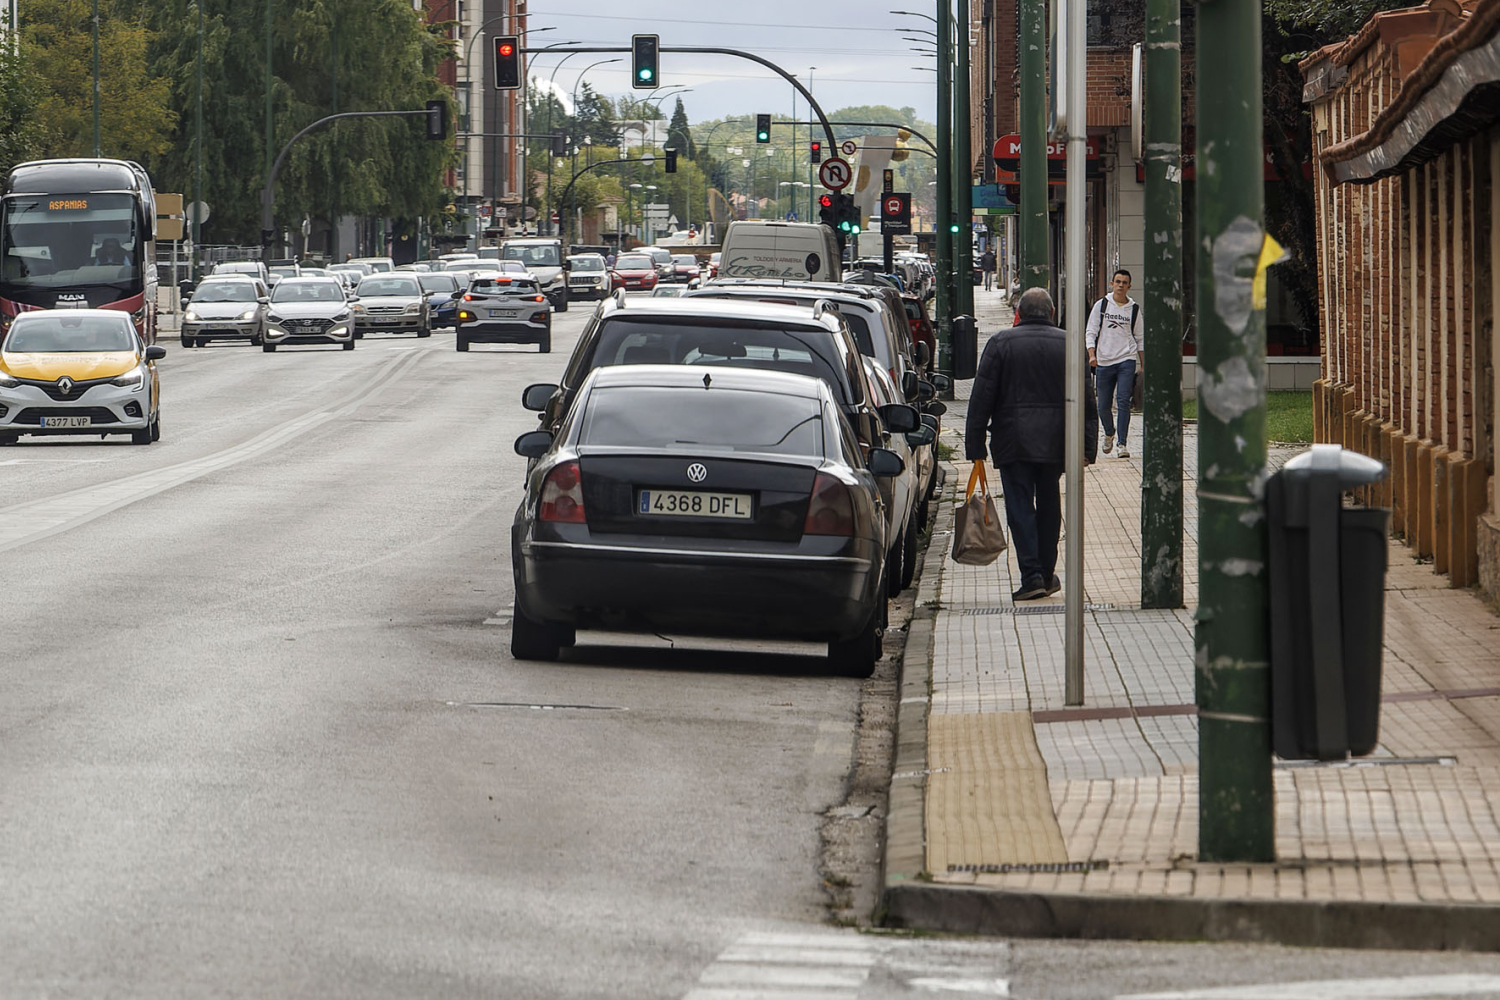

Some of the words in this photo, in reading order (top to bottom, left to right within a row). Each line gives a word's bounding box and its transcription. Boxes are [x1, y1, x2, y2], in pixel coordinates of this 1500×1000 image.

[49, 199, 88, 210] ASPANIAS
[46, 418, 68, 427] 4377
[70, 417, 88, 427] LVP
[653, 493, 702, 513] 4368
[709, 496, 746, 516] DFL
